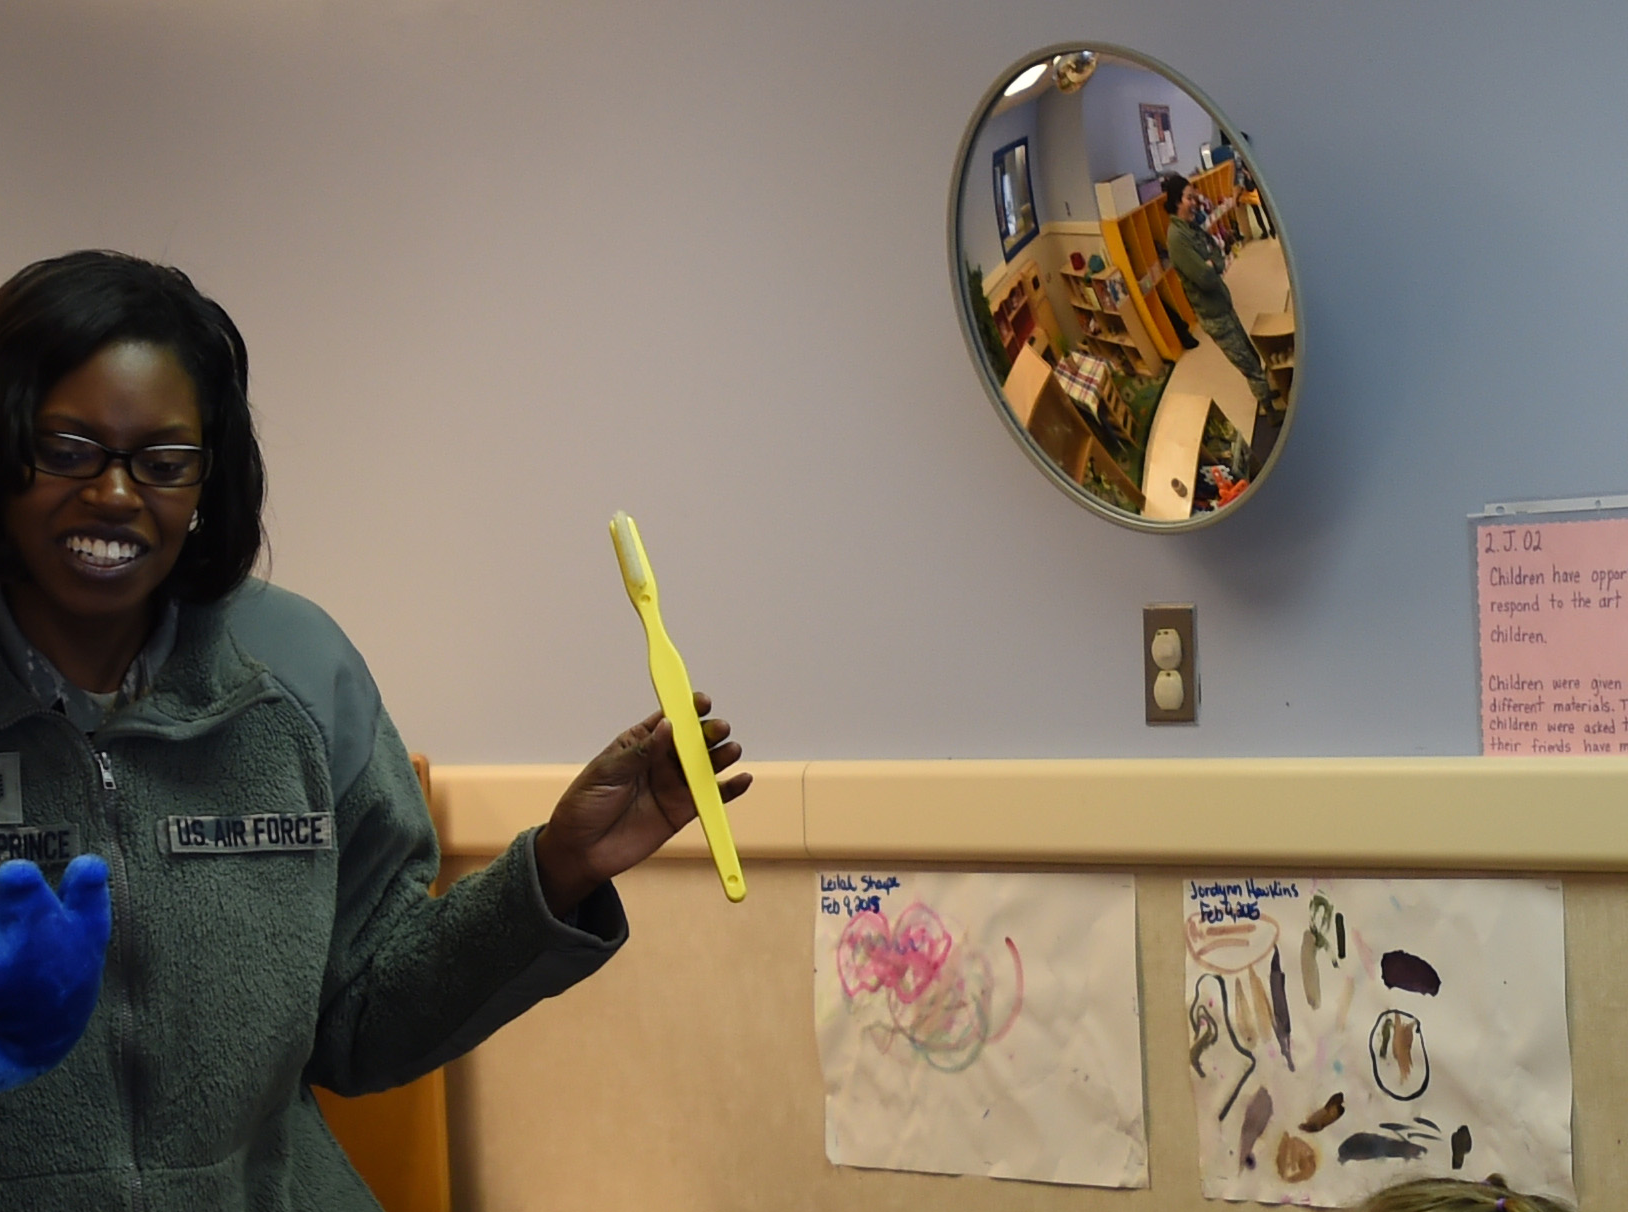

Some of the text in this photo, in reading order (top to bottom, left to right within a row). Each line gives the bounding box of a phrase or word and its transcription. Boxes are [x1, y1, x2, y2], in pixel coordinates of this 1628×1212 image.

[1490, 566, 1545, 586] Children
[1552, 563, 1580, 583] have
[1490, 590, 1622, 618] respond to the art
[1491, 624, 1547, 644] children.
[1488, 673, 1622, 697] Children were given
[1489, 695, 1545, 713] different
[1553, 696, 1615, 713] materials.
[1489, 716, 1538, 731] children
[1547, 722, 1575, 733] were
[1584, 718, 1616, 734] asked
[1490, 736, 1521, 752] their
[1532, 738, 1572, 753] friends
[1583, 738, 1611, 752] have
[215, 818, 247, 847] AIR
[253, 815, 323, 846] FORCE
[822, 896, 840, 914] Feb
[1200, 901, 1224, 924] Feb
